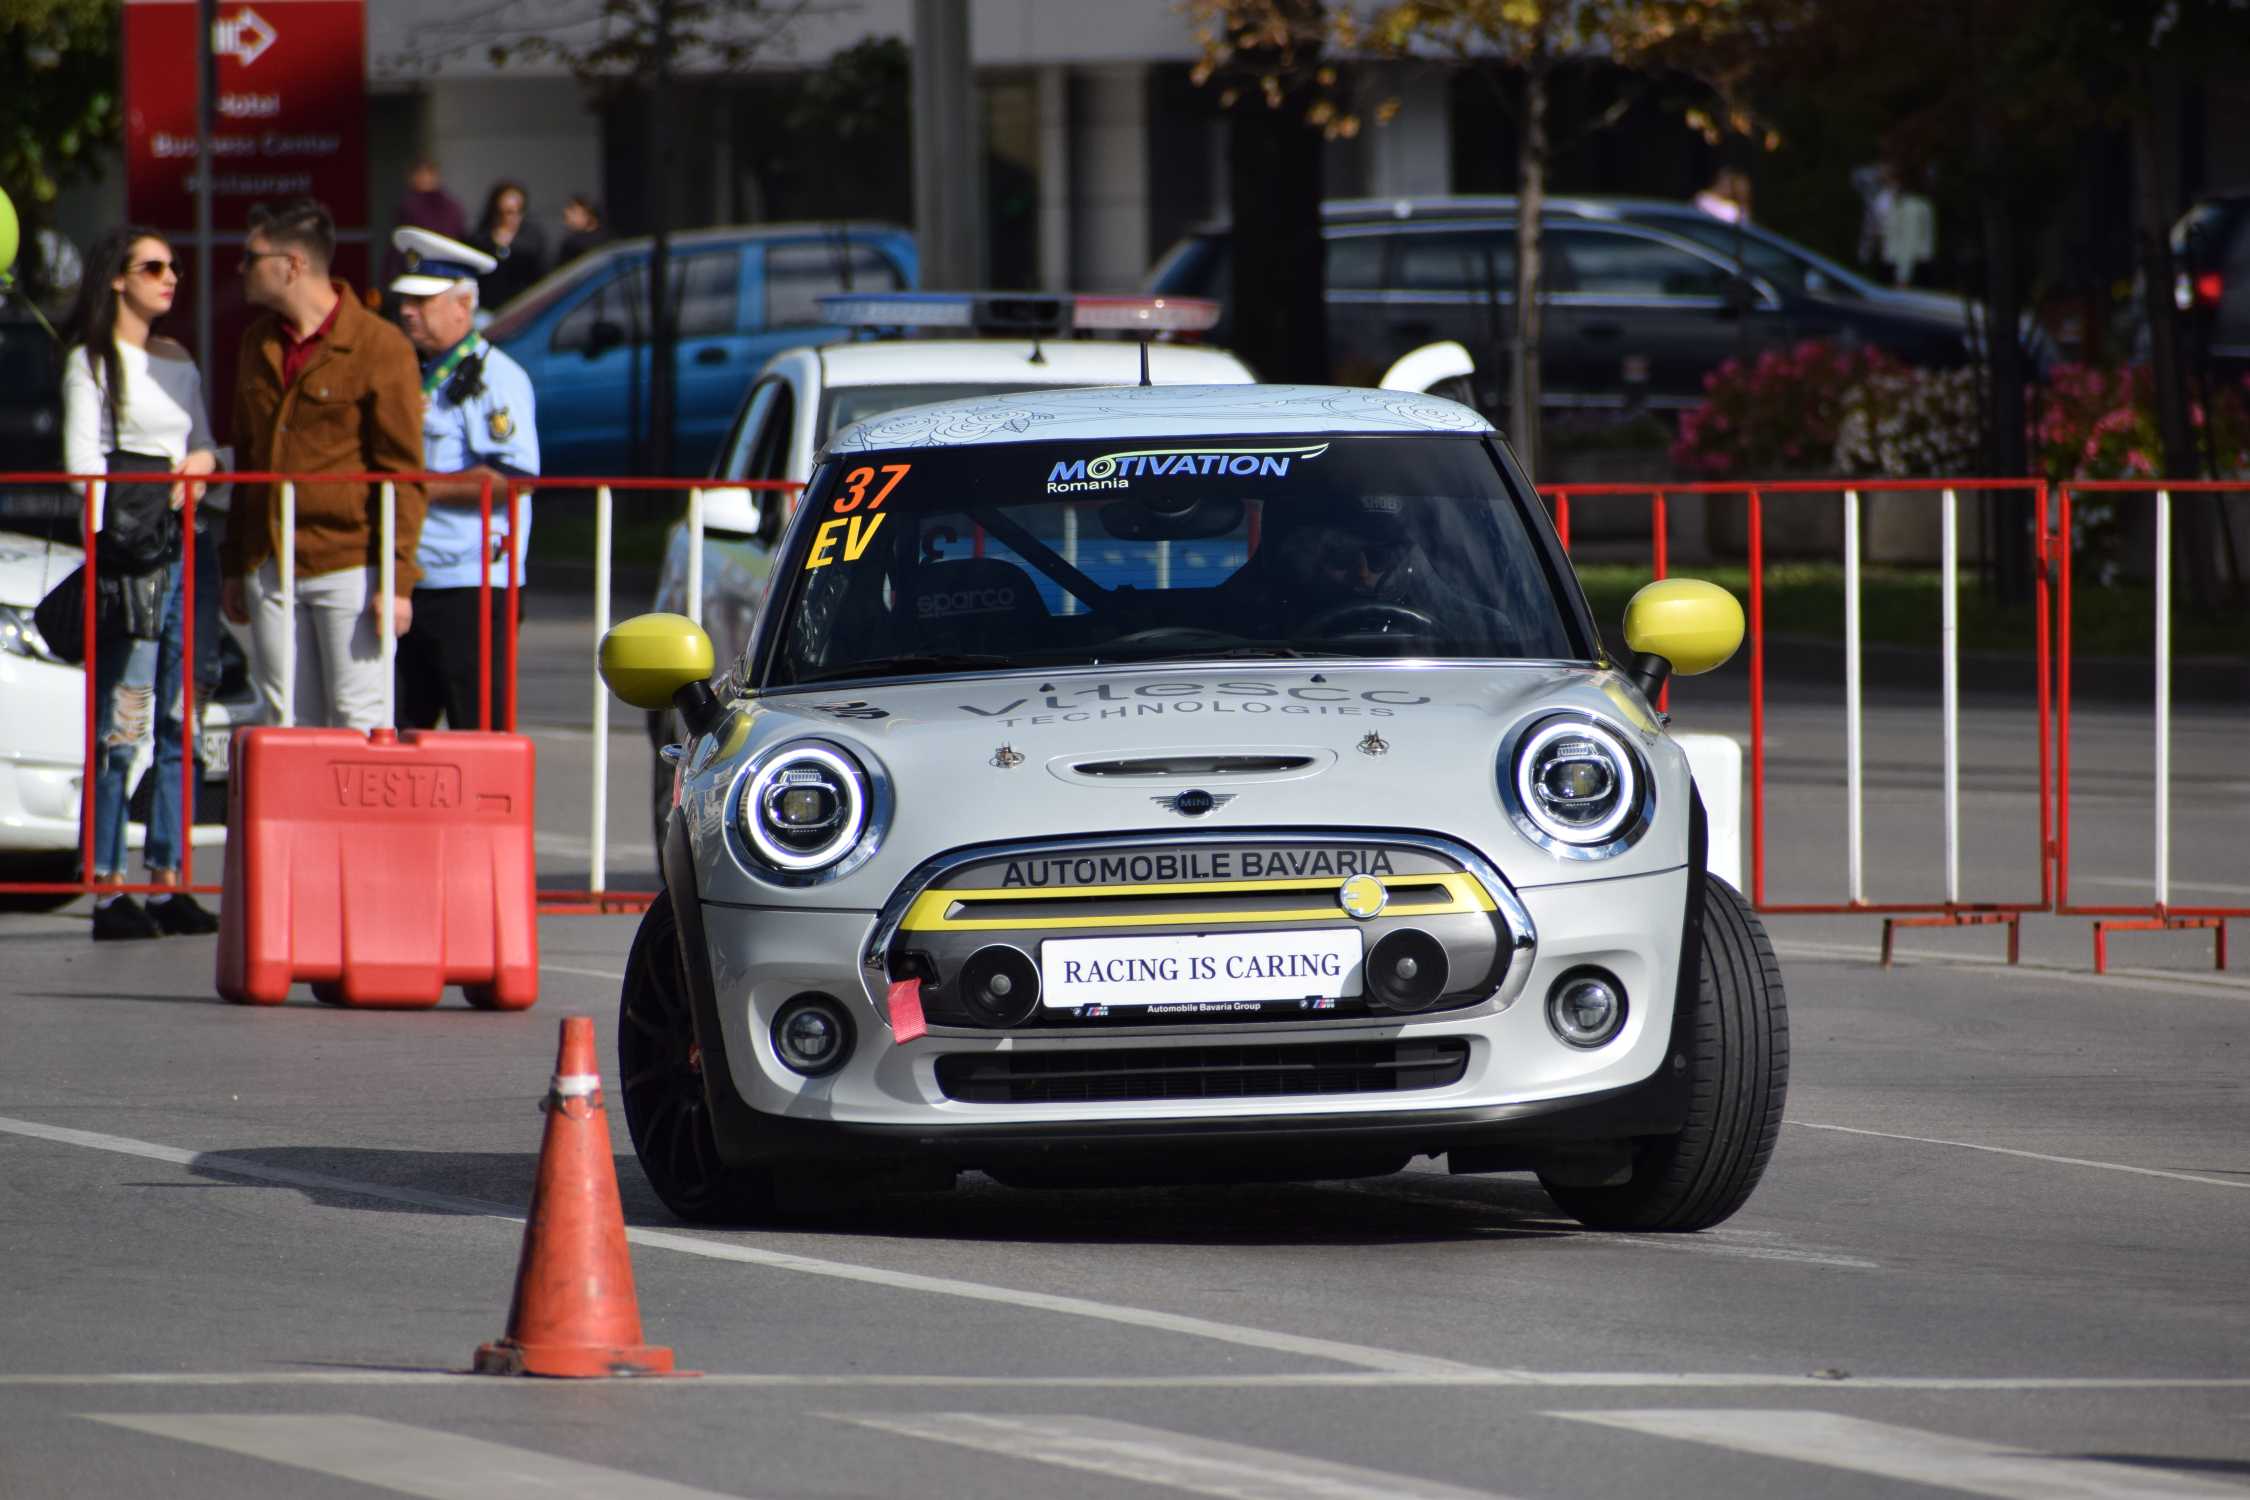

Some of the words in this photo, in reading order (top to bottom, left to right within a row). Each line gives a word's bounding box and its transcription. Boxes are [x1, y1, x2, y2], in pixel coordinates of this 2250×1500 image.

[1048, 454, 1290, 482] MOTIVATION
[833, 464, 912, 513] 37
[1047, 477, 1129, 494] Romania
[805, 512, 886, 570] EV
[915, 587, 1015, 618] sparco
[958, 681, 1430, 716] vitesco
[998, 701, 1395, 727] TECHNOLOGIES
[332, 766, 452, 808] VESTA
[1002, 852, 1231, 888] AUTOMOBILE
[1242, 849, 1394, 877] BAVARIA
[1063, 957, 1178, 984] RACING
[1188, 956, 1217, 980] IS
[1226, 953, 1341, 979] CARING
[1147, 1003, 1198, 1014] Automobile
[1200, 1002, 1232, 1012] Bavaria
[1233, 1002, 1261, 1012] Group
